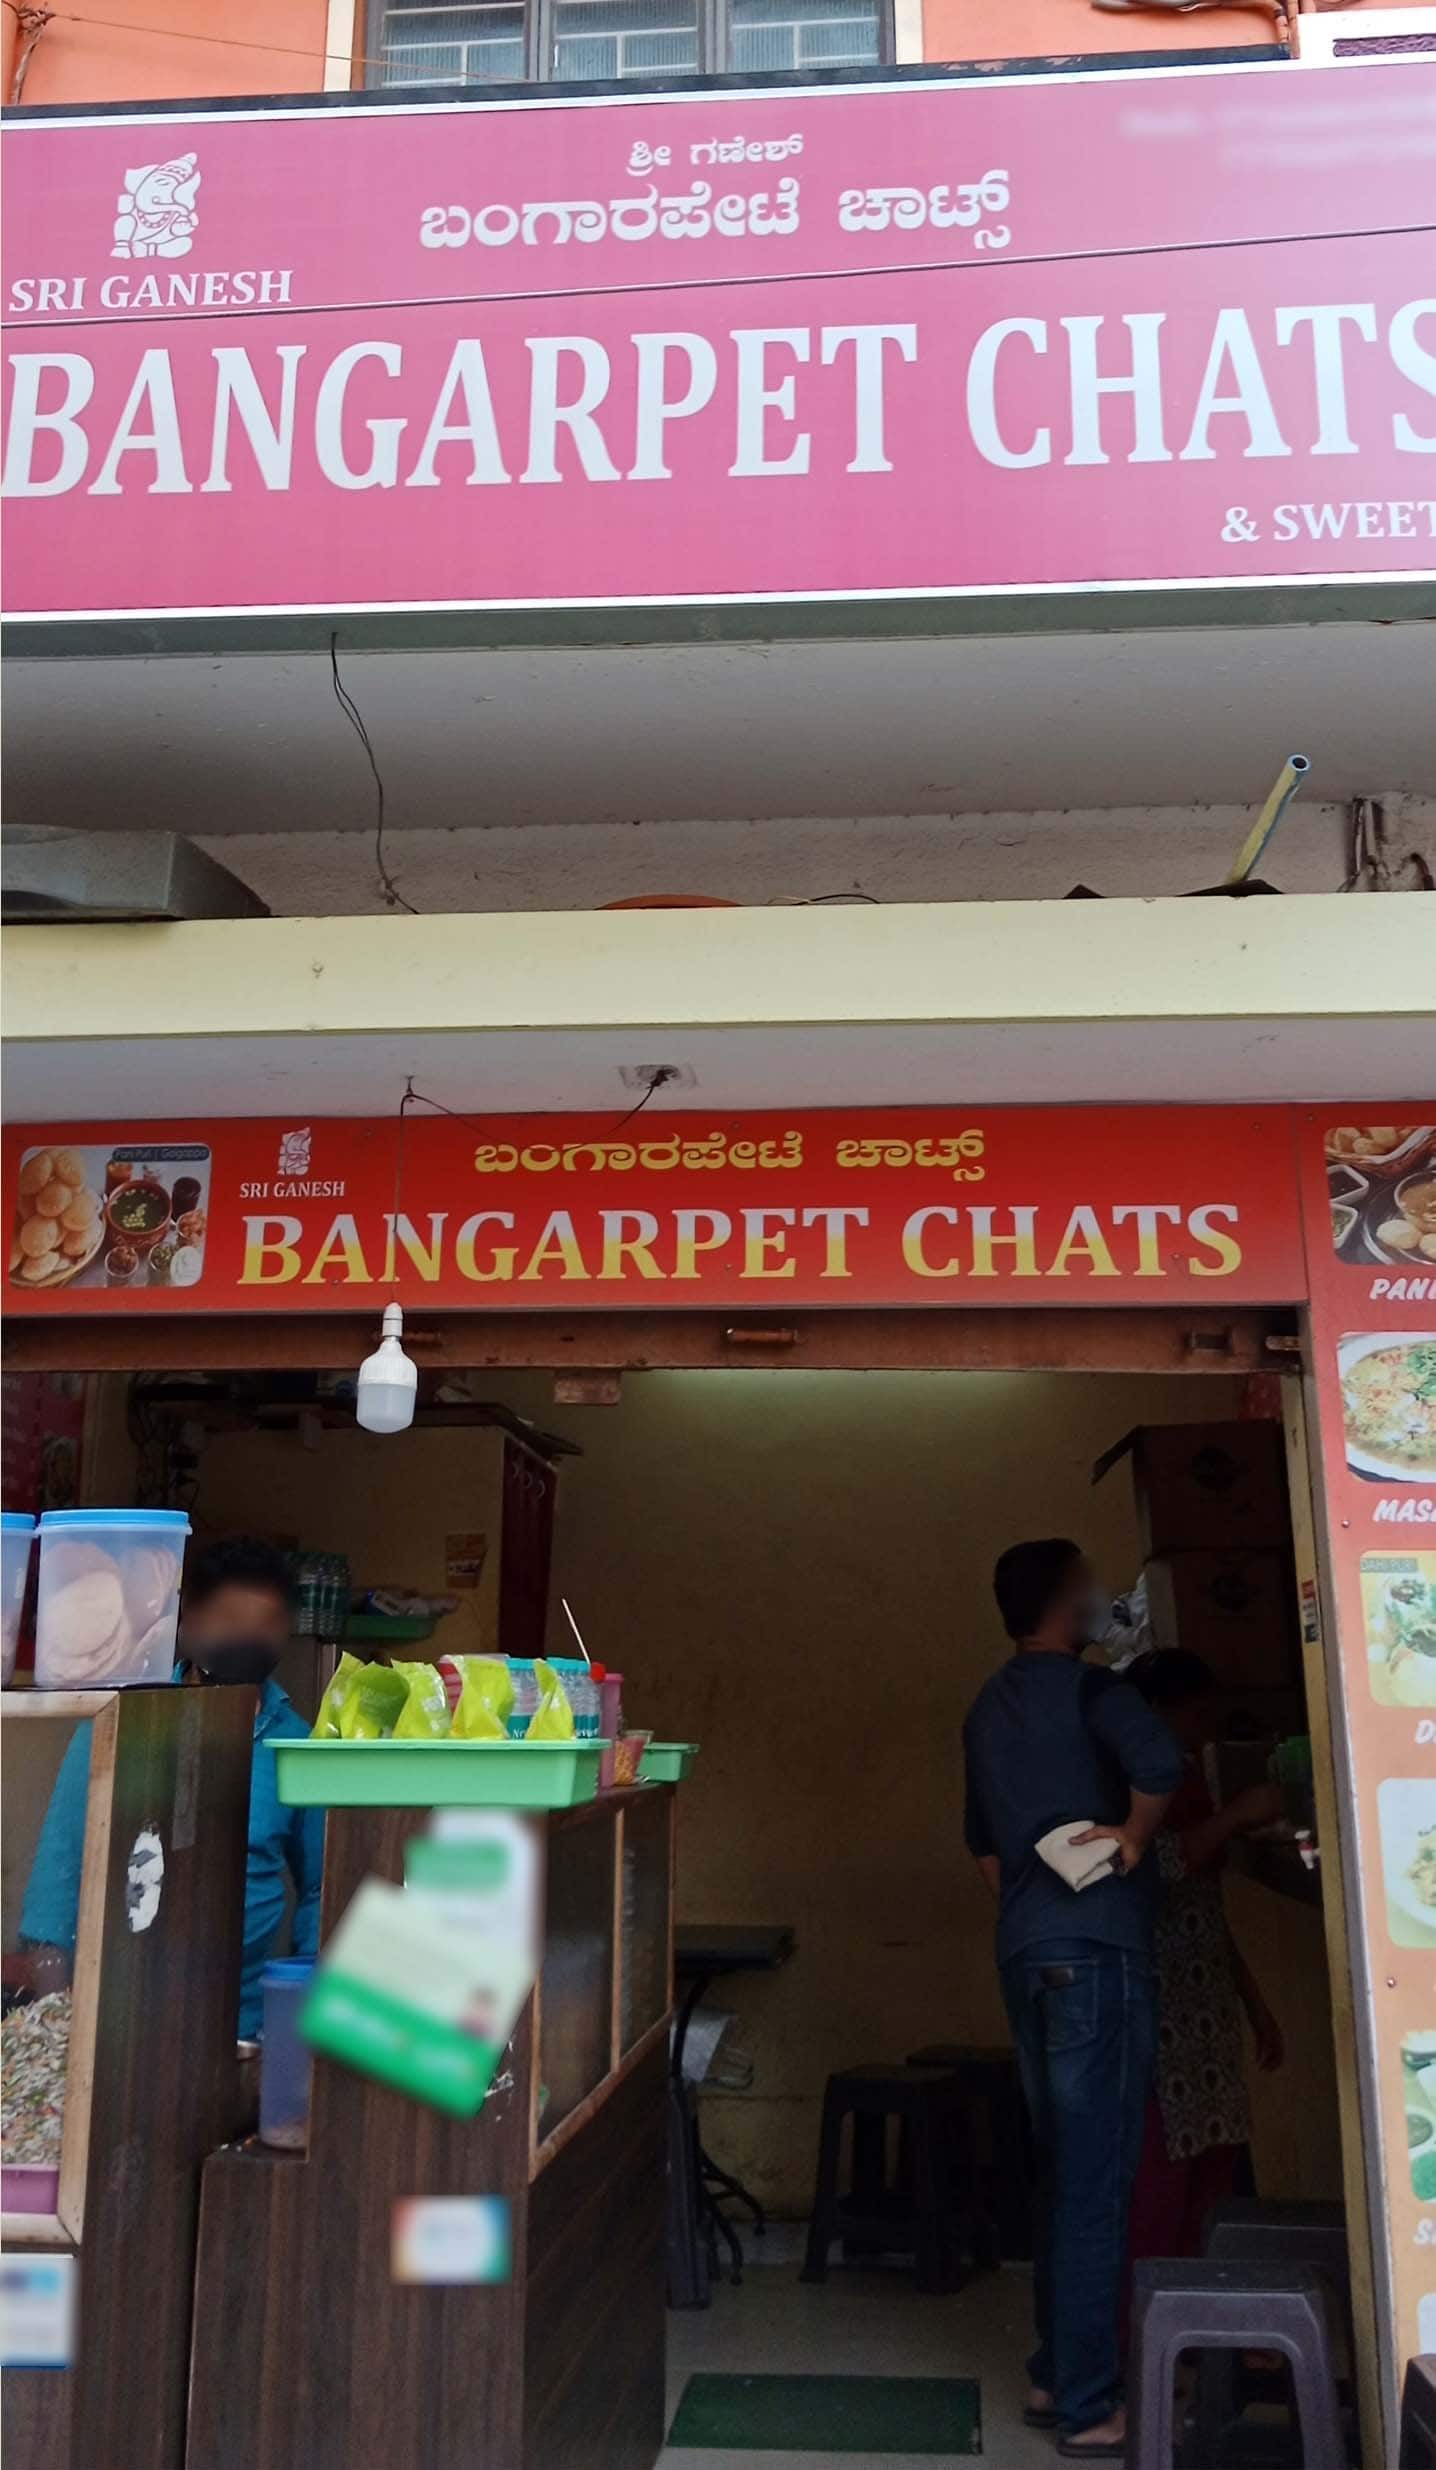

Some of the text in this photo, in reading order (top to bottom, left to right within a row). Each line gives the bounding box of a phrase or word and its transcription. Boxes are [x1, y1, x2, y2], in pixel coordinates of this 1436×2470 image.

[626, 132, 805, 177] ಶ್ರೀ ಗಣೇಶ್
[419, 176, 800, 249] ಬಂಗಾರಪೇಟೆ
[8, 269, 295, 313] SRI GANESH
[2, 299, 1436, 498] BANGARPET CHATS
[1220, 506, 1262, 543] &
[474, 1130, 803, 1173] ಬಂಗಾರಪೇಟೆ
[239, 1180, 346, 1198] SRI GANESH
[236, 1203, 1243, 1285] BANGARPET CHATS
